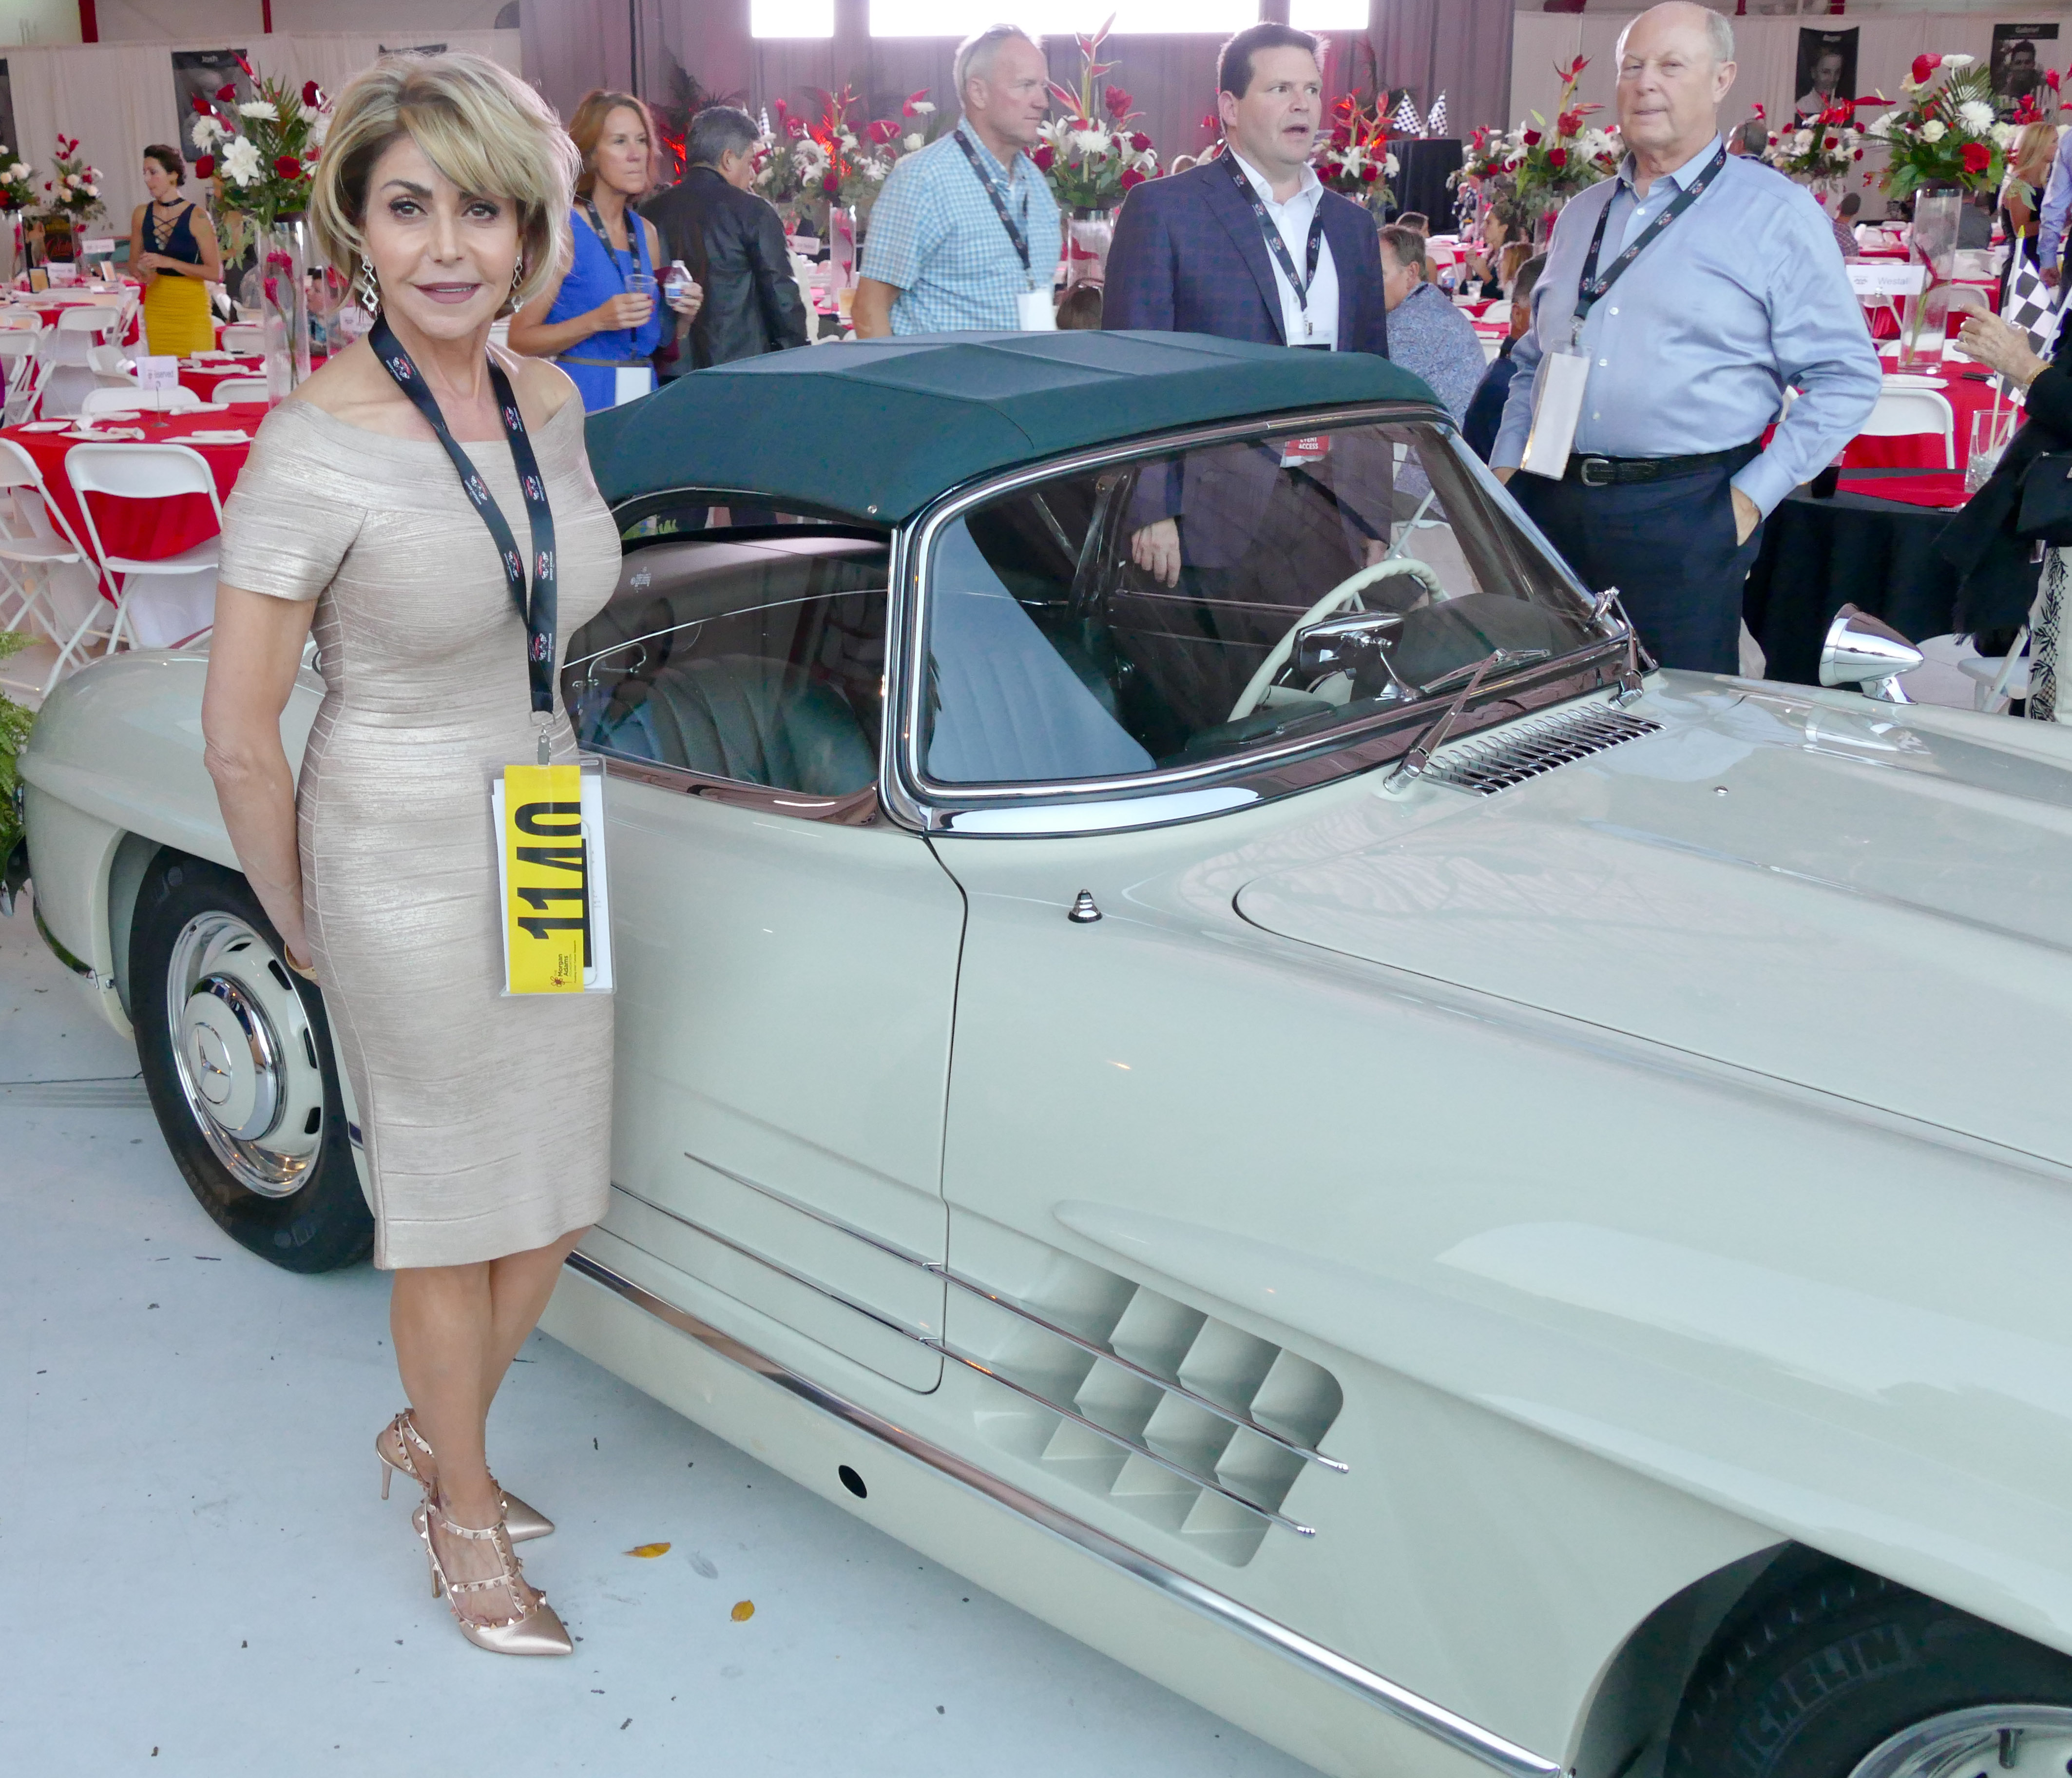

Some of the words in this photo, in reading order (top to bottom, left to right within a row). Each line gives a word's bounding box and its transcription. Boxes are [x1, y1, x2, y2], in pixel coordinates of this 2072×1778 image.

[464, 480, 473, 490] ADAMS
[472, 490, 481, 504] MORGAN
[514, 802, 584, 939] 1140
